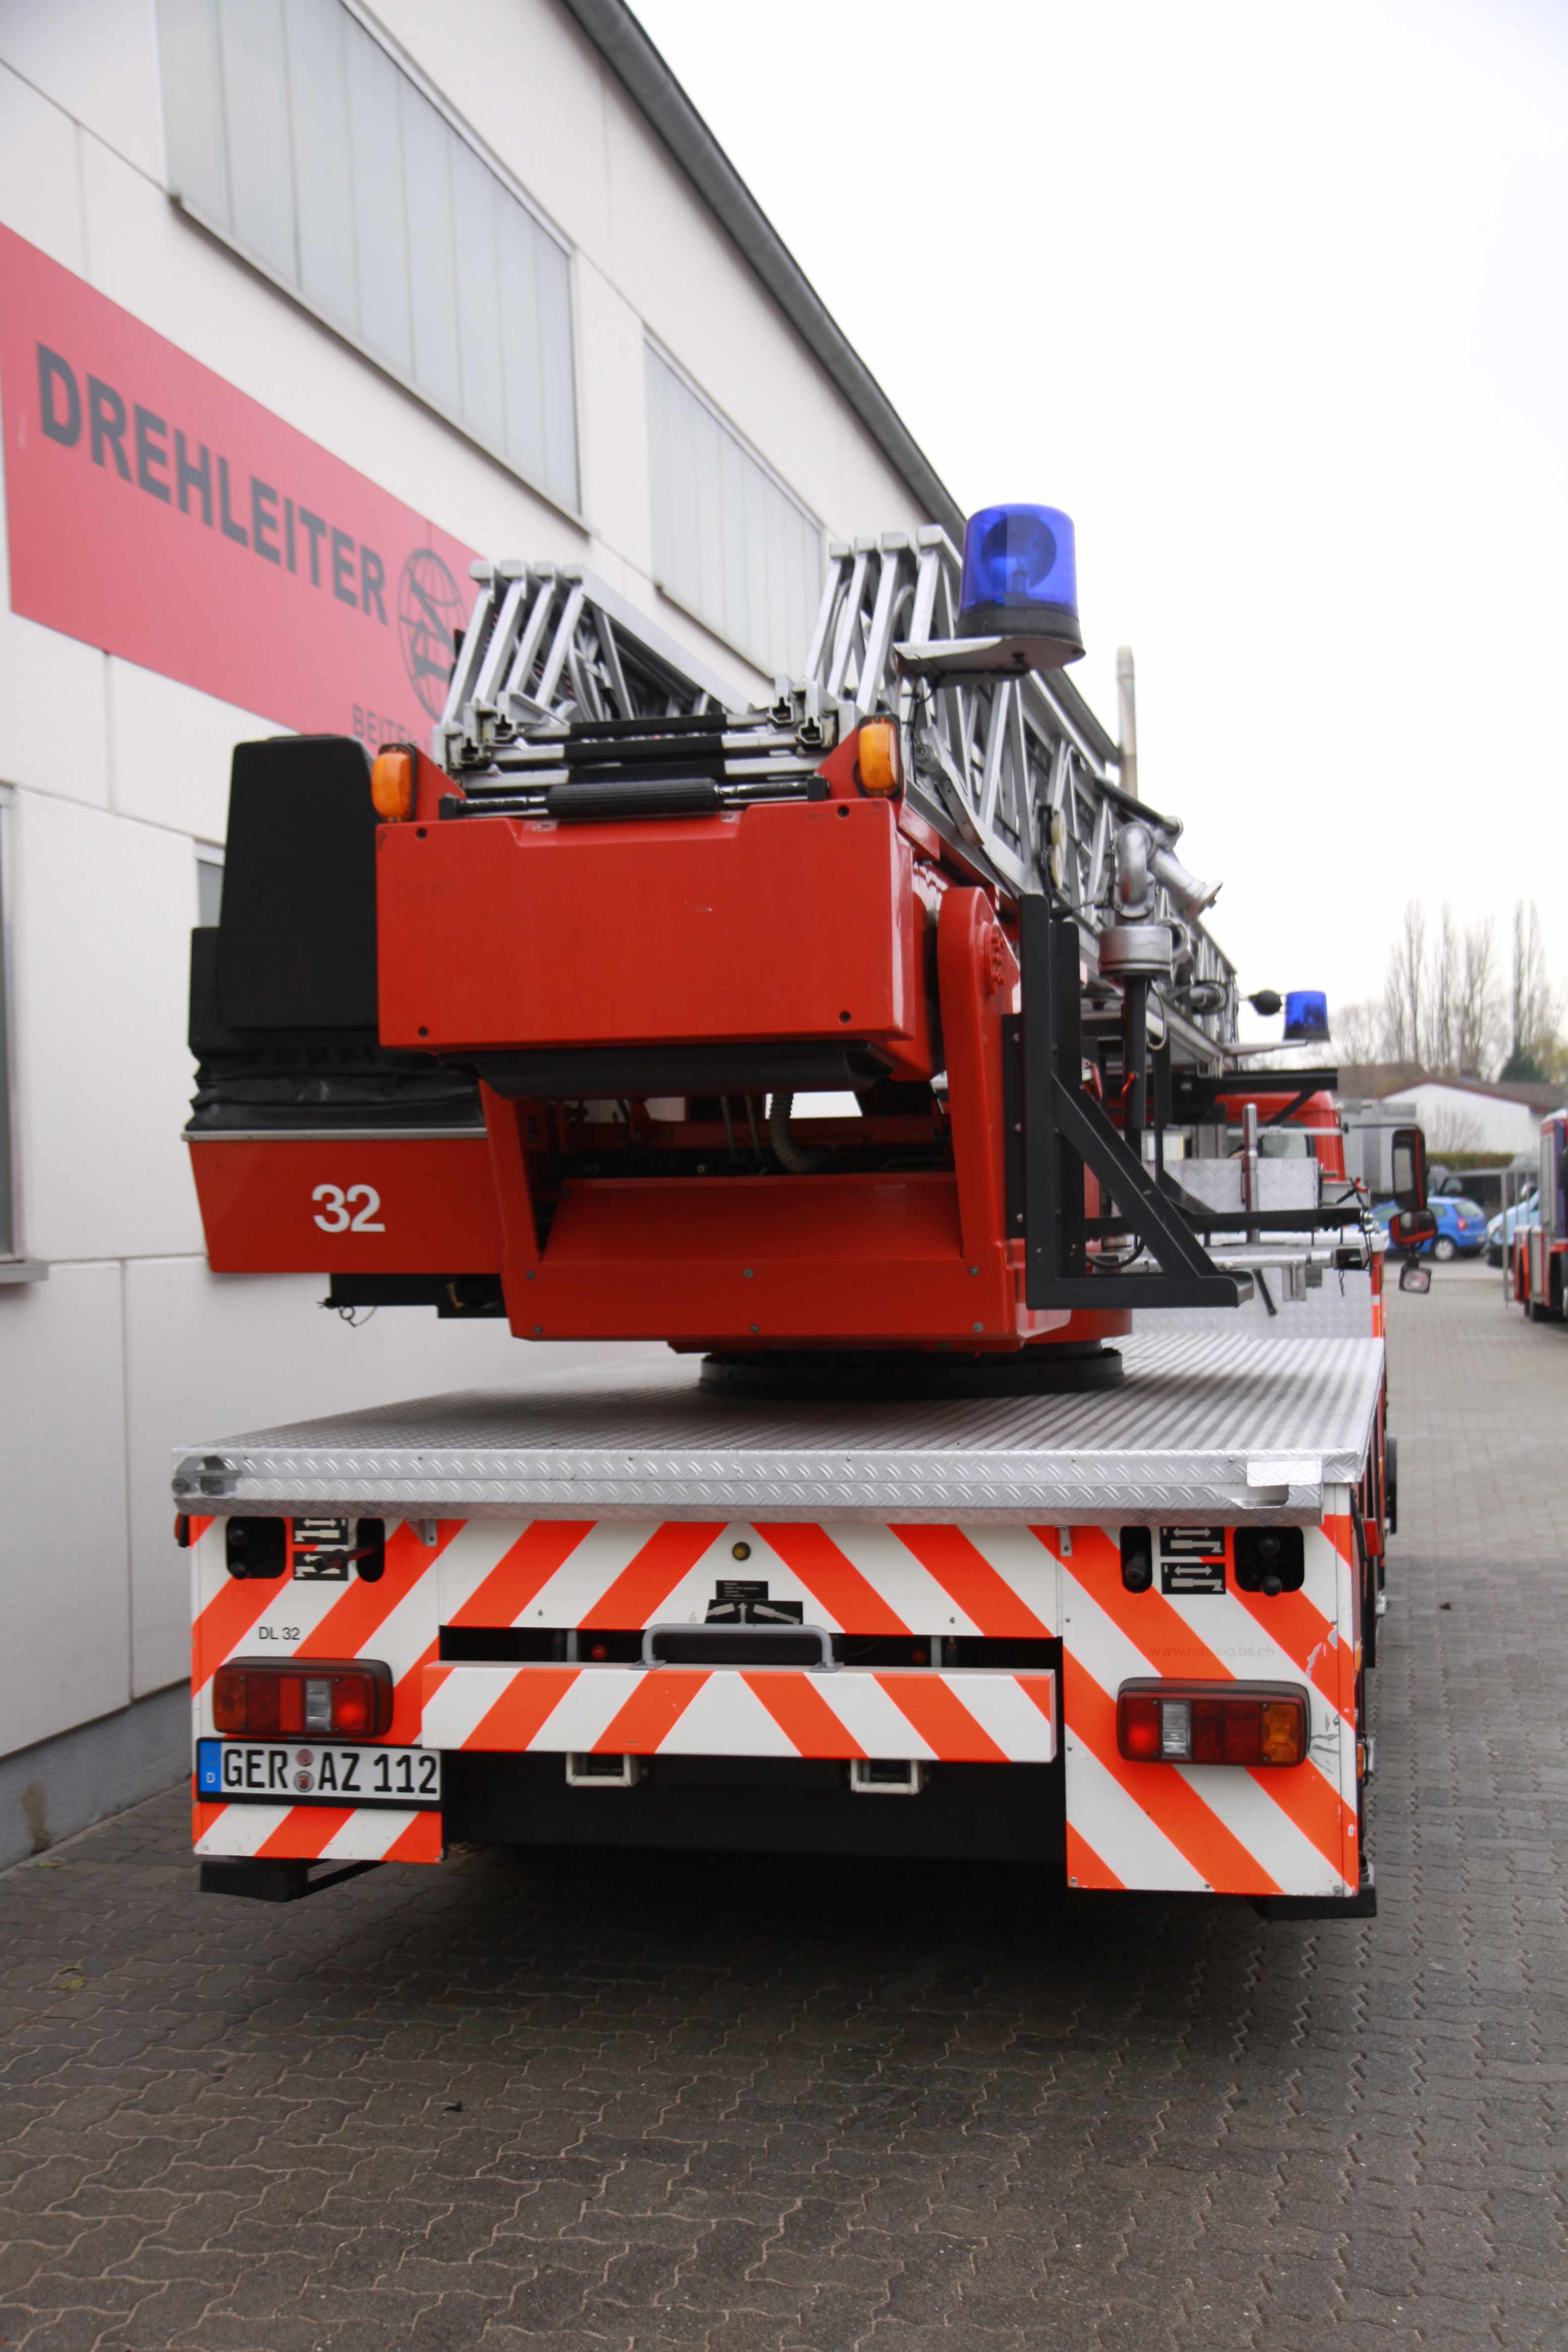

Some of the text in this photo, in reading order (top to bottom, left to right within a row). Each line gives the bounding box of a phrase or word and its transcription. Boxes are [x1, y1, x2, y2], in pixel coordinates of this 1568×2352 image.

[36, 341, 388, 627] DREHLEITER
[311, 1184, 386, 1233] 32
[258, 1626, 300, 1640] DL 32
[206, 1749, 438, 1794] D GER AZ 112
